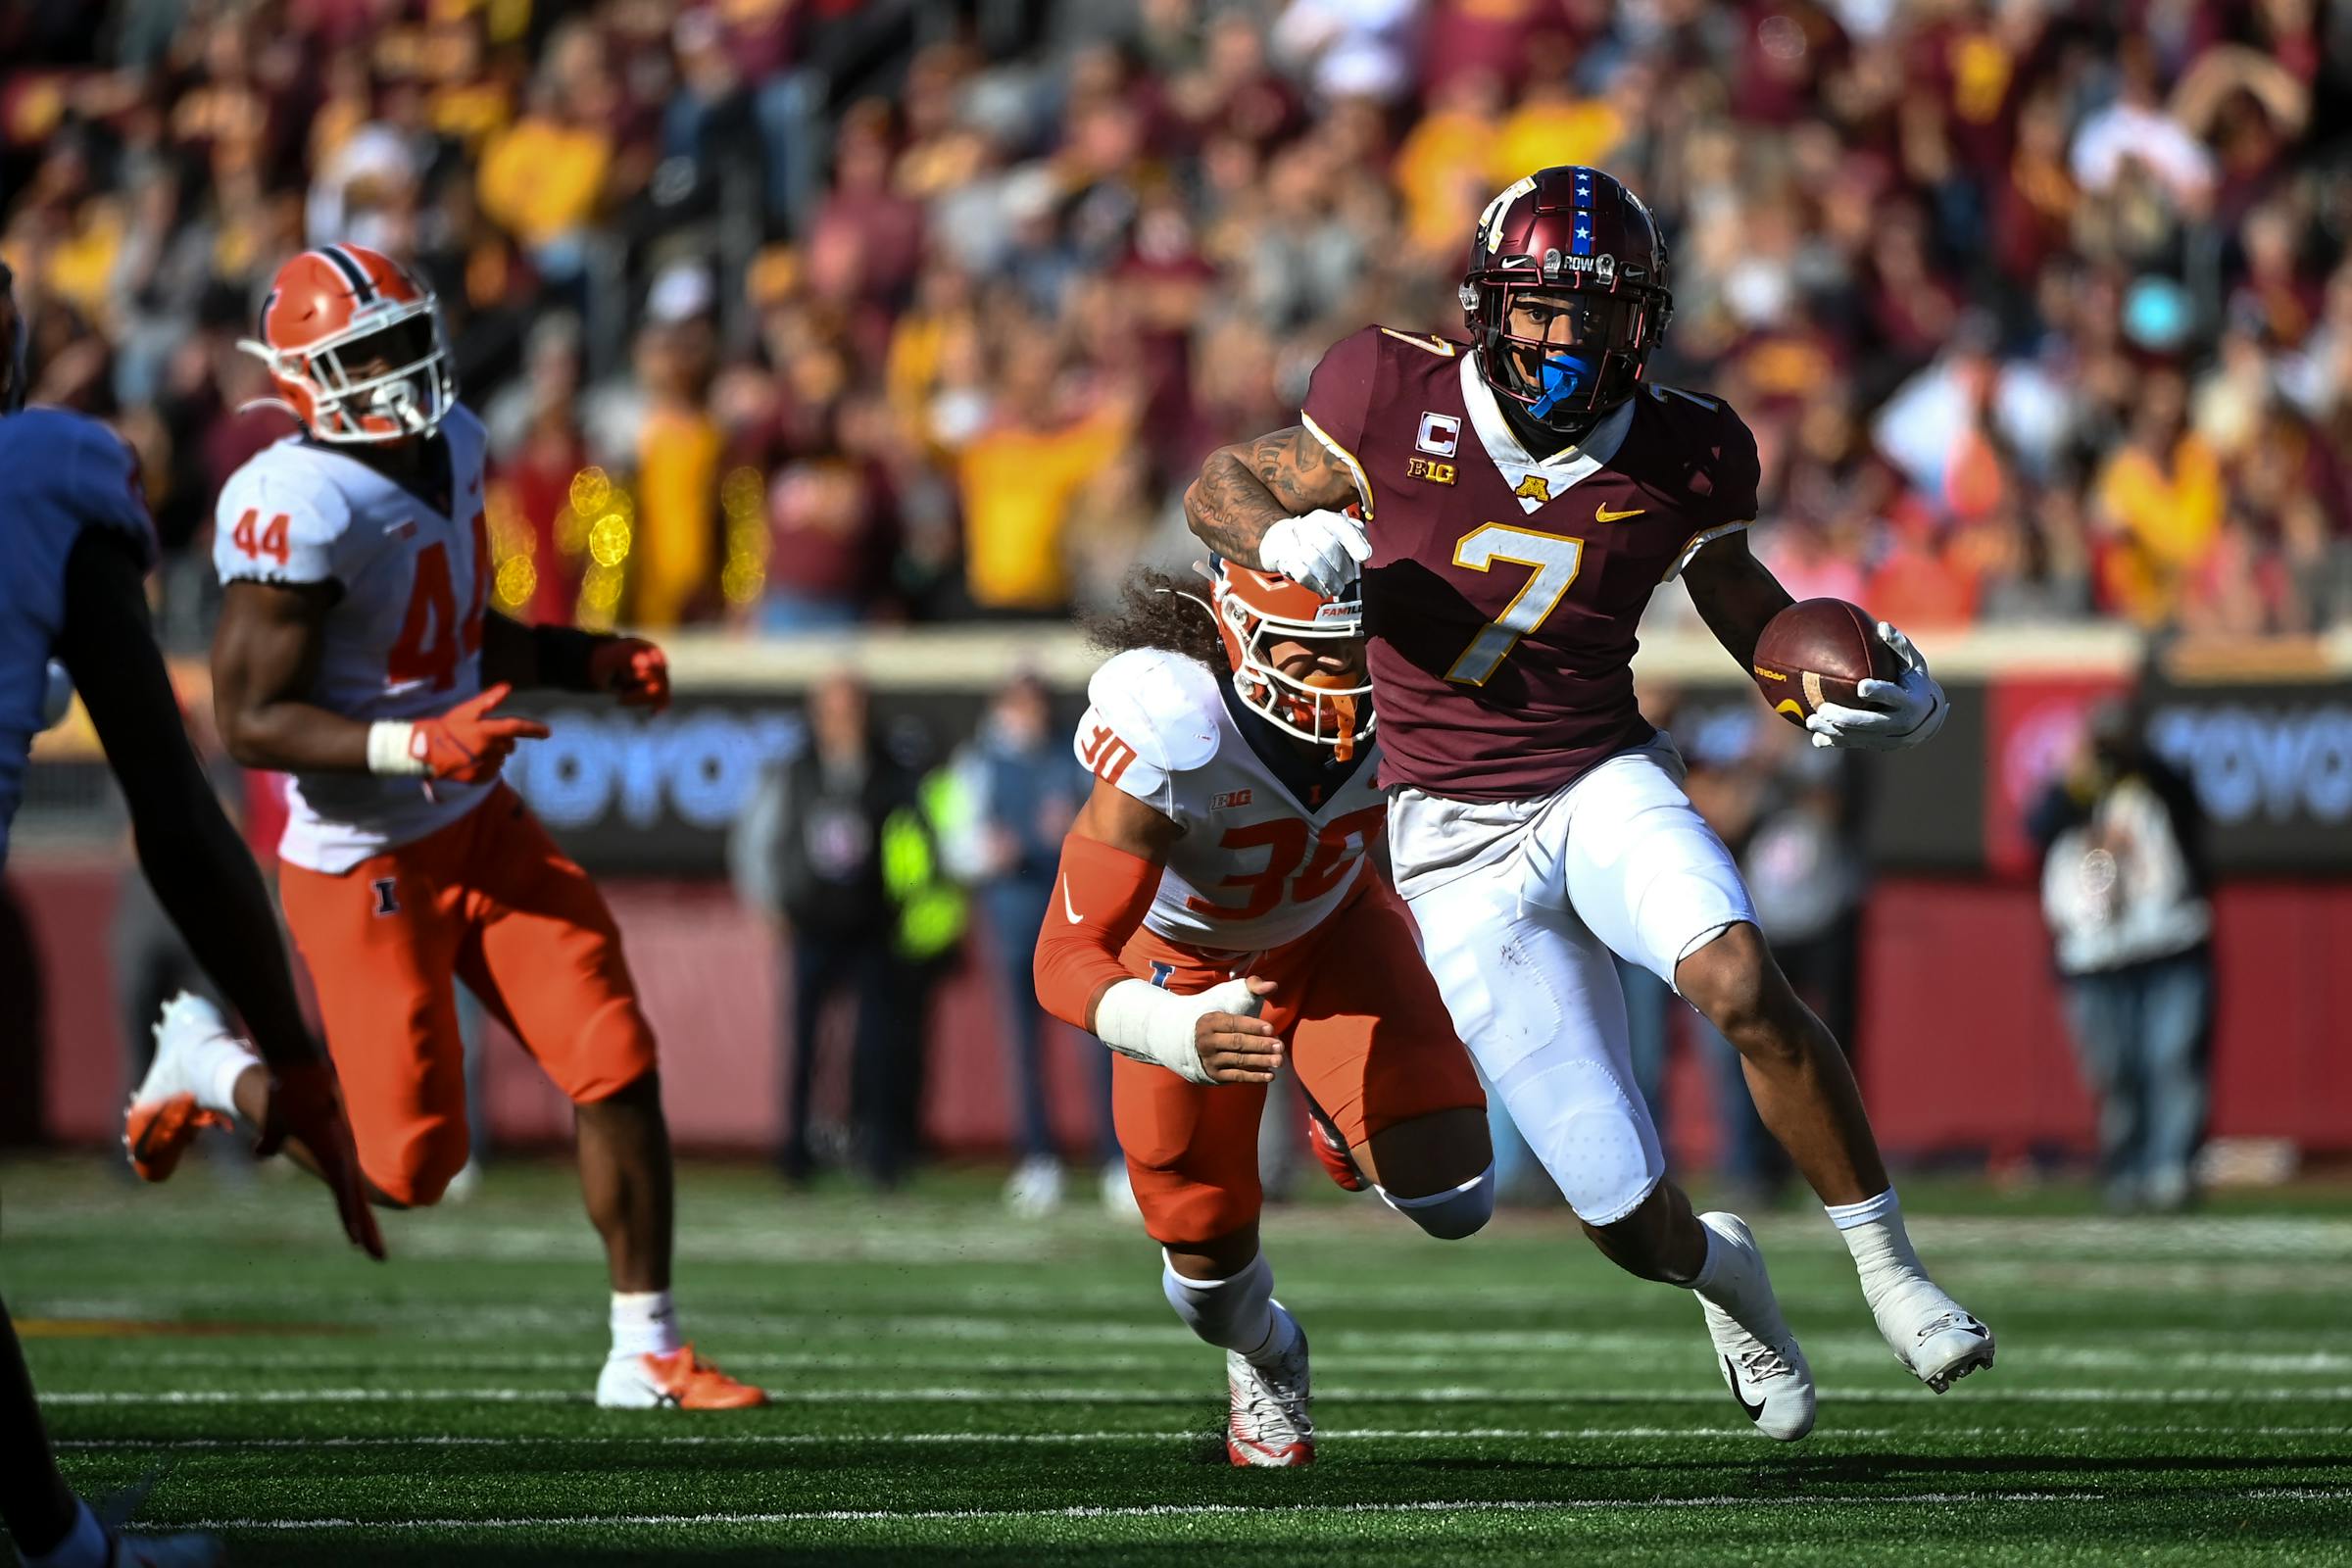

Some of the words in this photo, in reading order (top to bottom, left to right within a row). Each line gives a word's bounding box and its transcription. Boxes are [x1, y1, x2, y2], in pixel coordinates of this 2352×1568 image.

[1418, 414, 1457, 454] C
[1515, 474, 1550, 502] M
[231, 508, 291, 566] 44
[1443, 520, 1585, 687] 7
[1080, 723, 1138, 786] 30
[1186, 803, 1389, 921] 30
